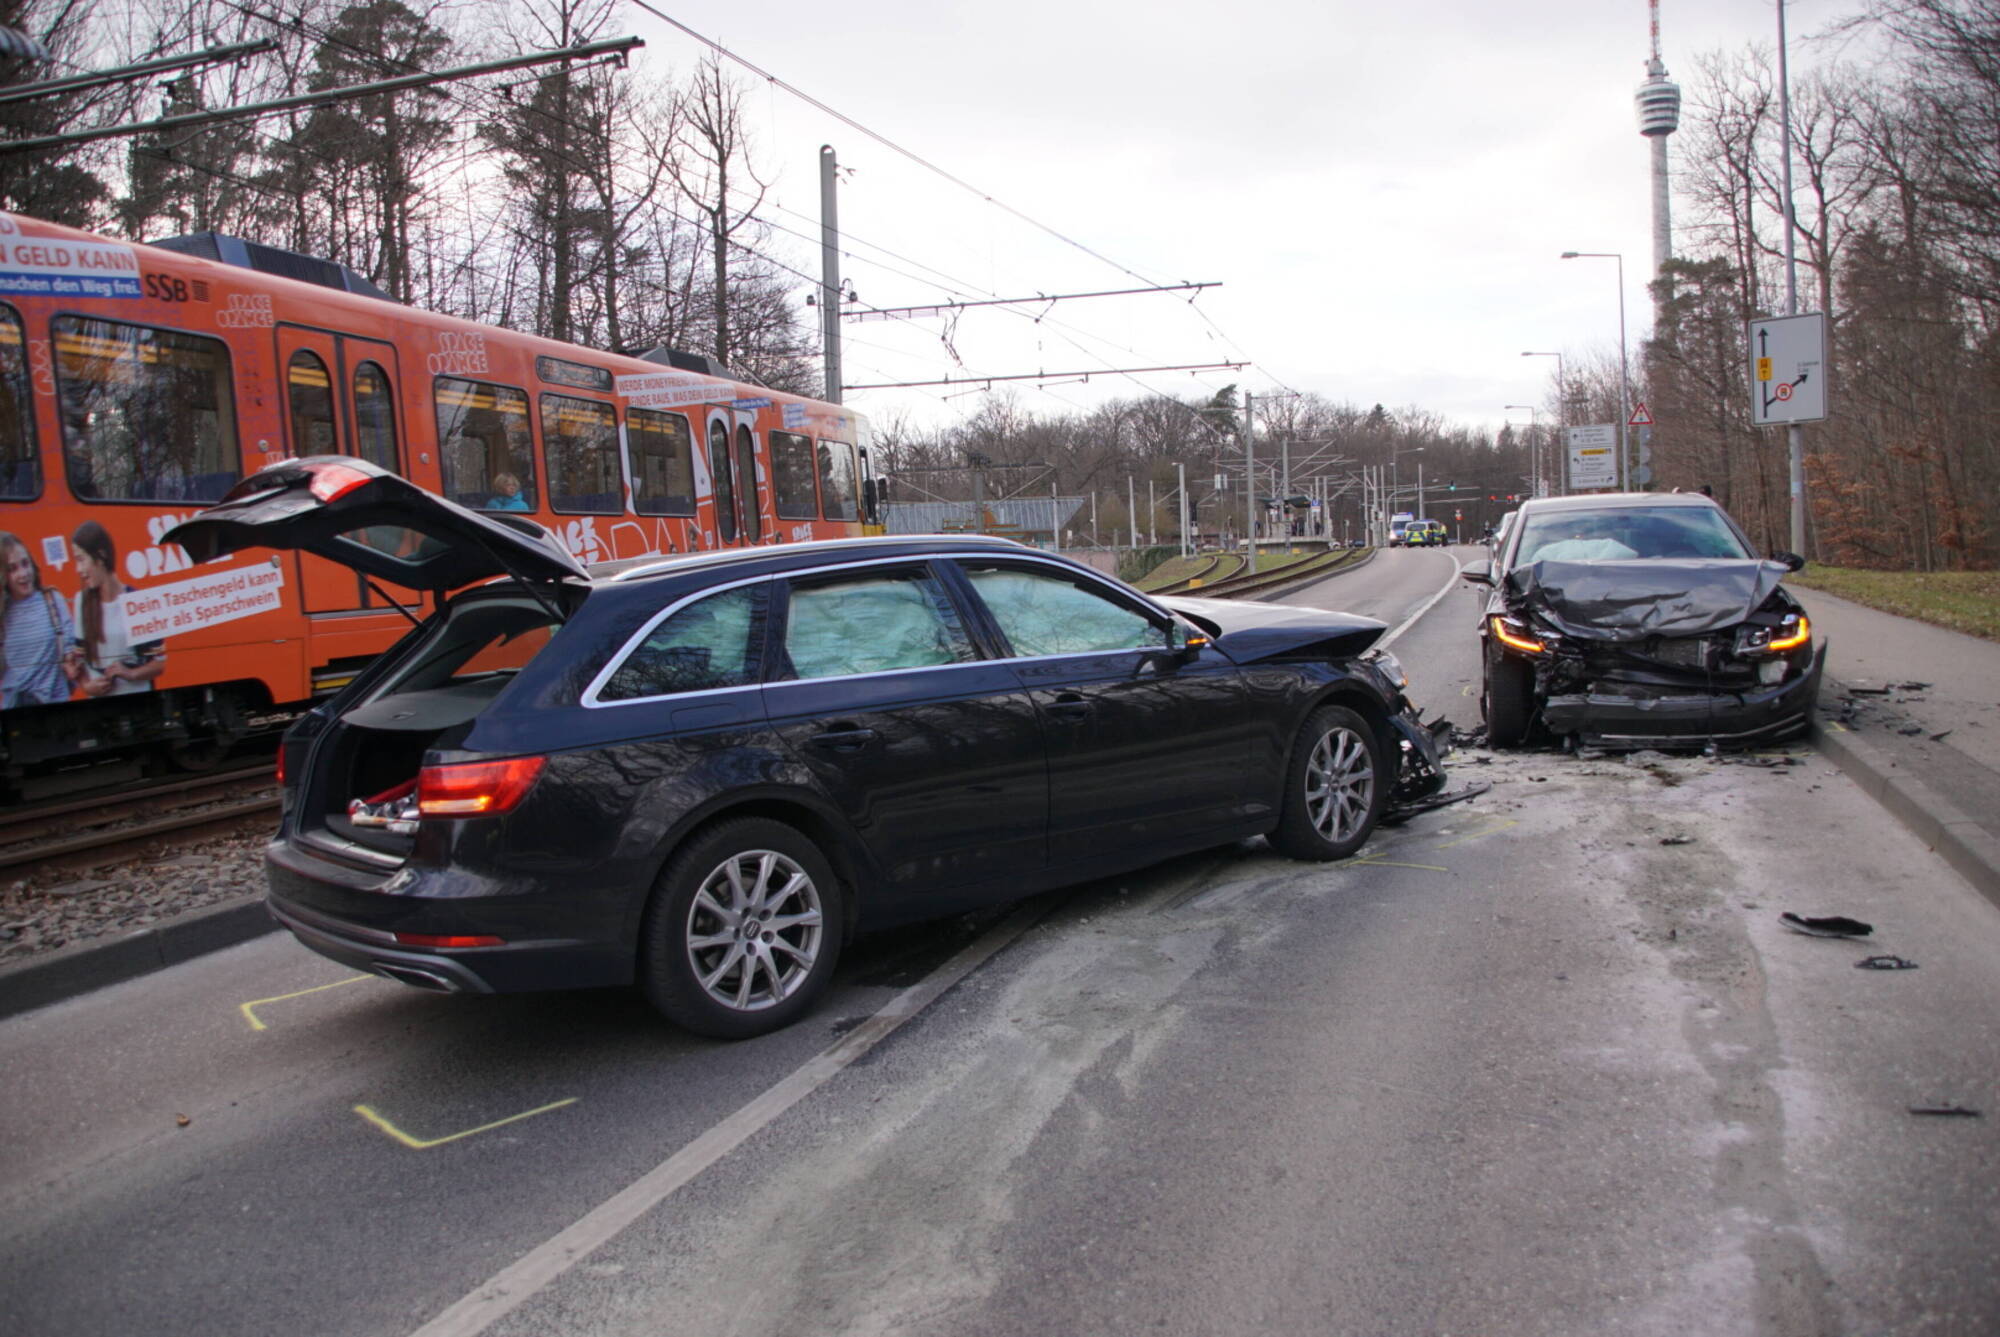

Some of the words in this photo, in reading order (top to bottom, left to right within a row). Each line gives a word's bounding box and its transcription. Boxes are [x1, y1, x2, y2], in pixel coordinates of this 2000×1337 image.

[13, 245, 71, 267] GELD
[76, 248, 136, 271] KANN
[146, 274, 189, 302] SSB
[427, 351, 488, 375] ORANGE
[126, 596, 161, 616] Dein
[163, 576, 245, 607] Taschengeld
[248, 571, 278, 587] kann
[131, 616, 169, 637] mehr
[173, 609, 192, 627] als
[195, 591, 275, 622] Sparschwein
